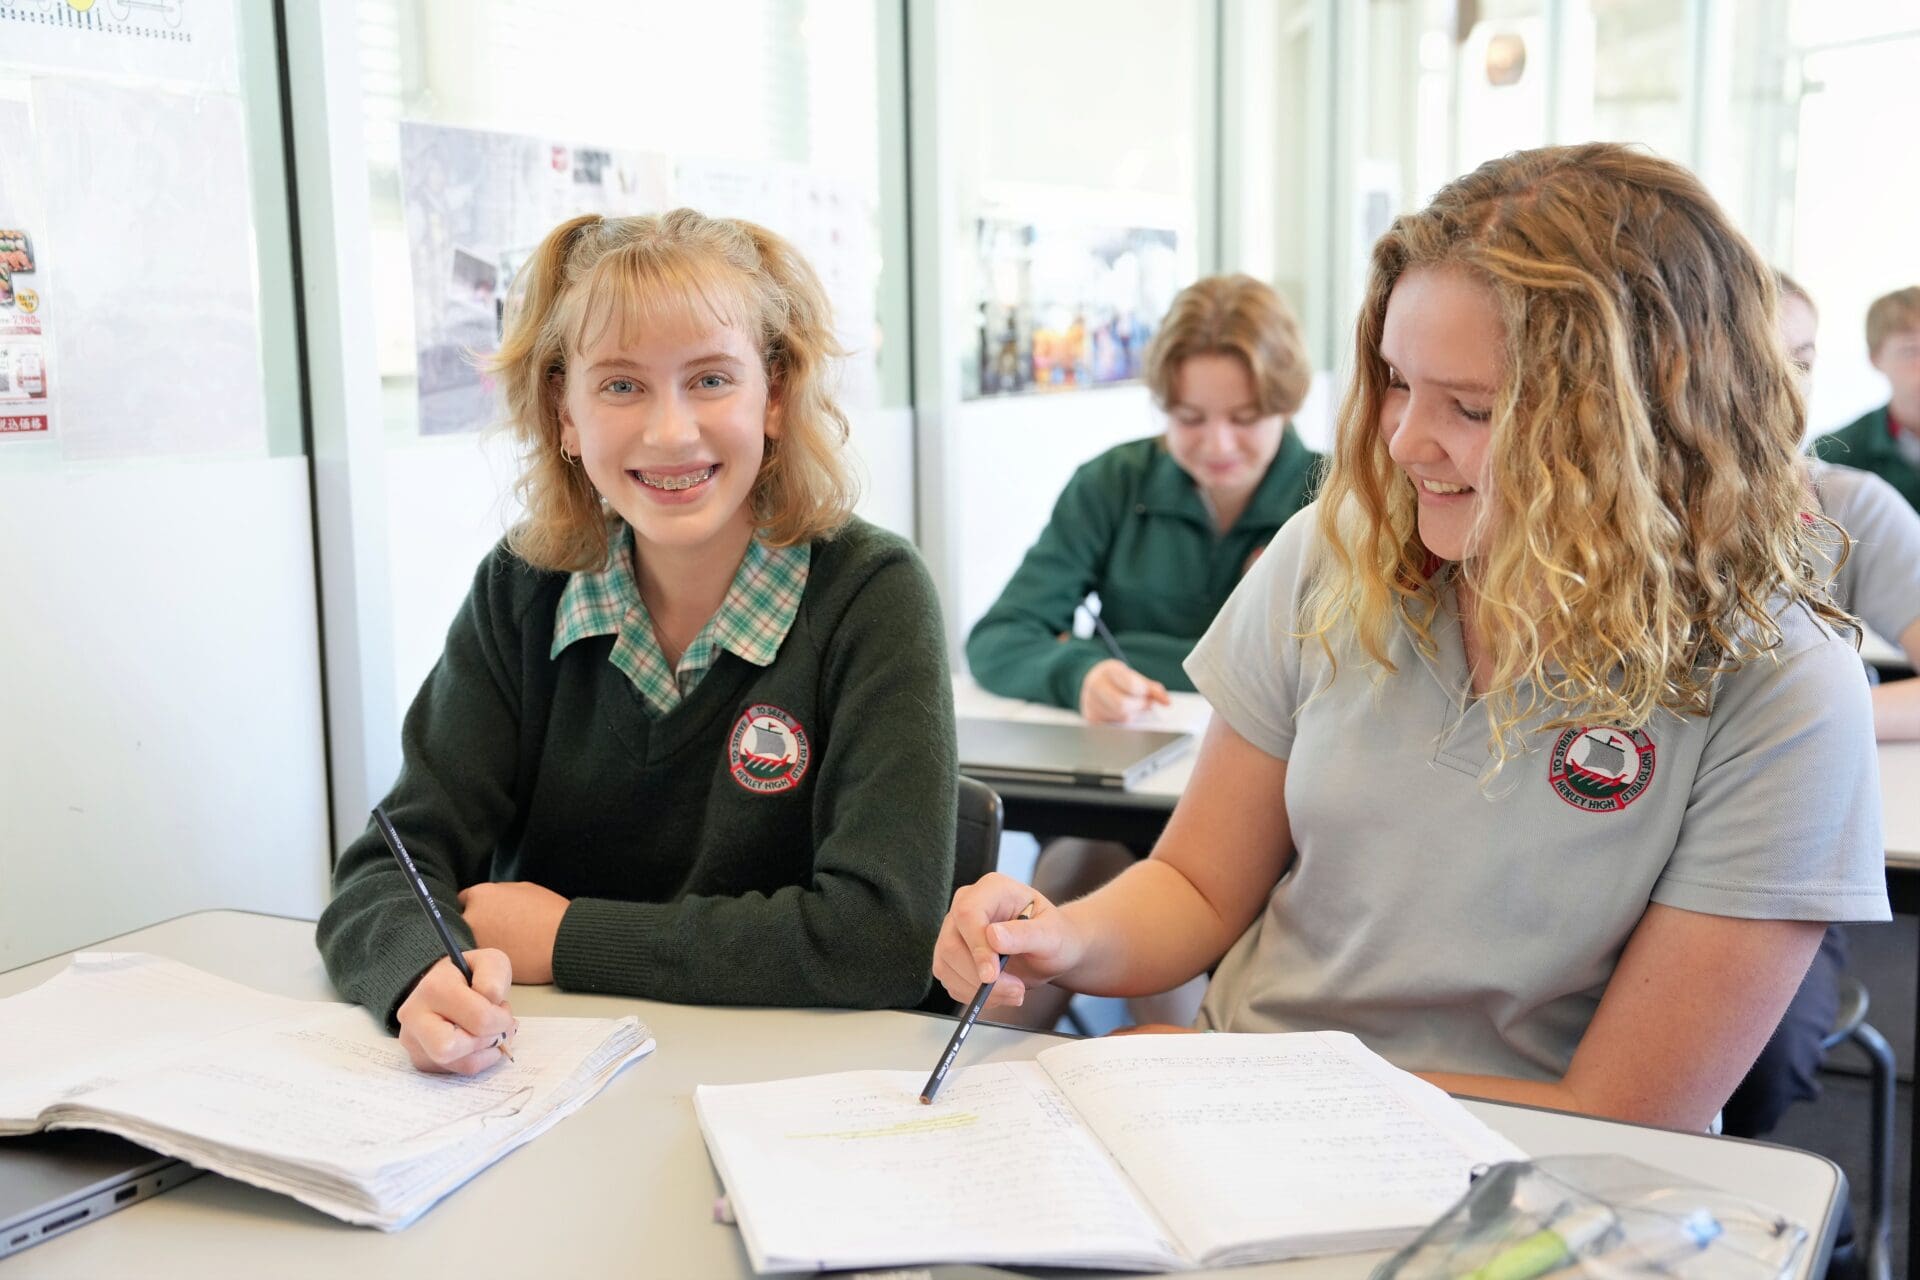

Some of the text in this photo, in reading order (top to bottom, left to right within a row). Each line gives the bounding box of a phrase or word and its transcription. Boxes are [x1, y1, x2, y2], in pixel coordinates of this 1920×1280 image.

[757, 706, 766, 715] TO
[1553, 727, 1579, 773] TO STRIVE
[1641, 752, 1652, 770] NOT
[736, 770, 789, 790] HENLEY HIGH
[1556, 780, 1616, 810] HENLEY HIGH
[1621, 781, 1645, 801] YIELD
